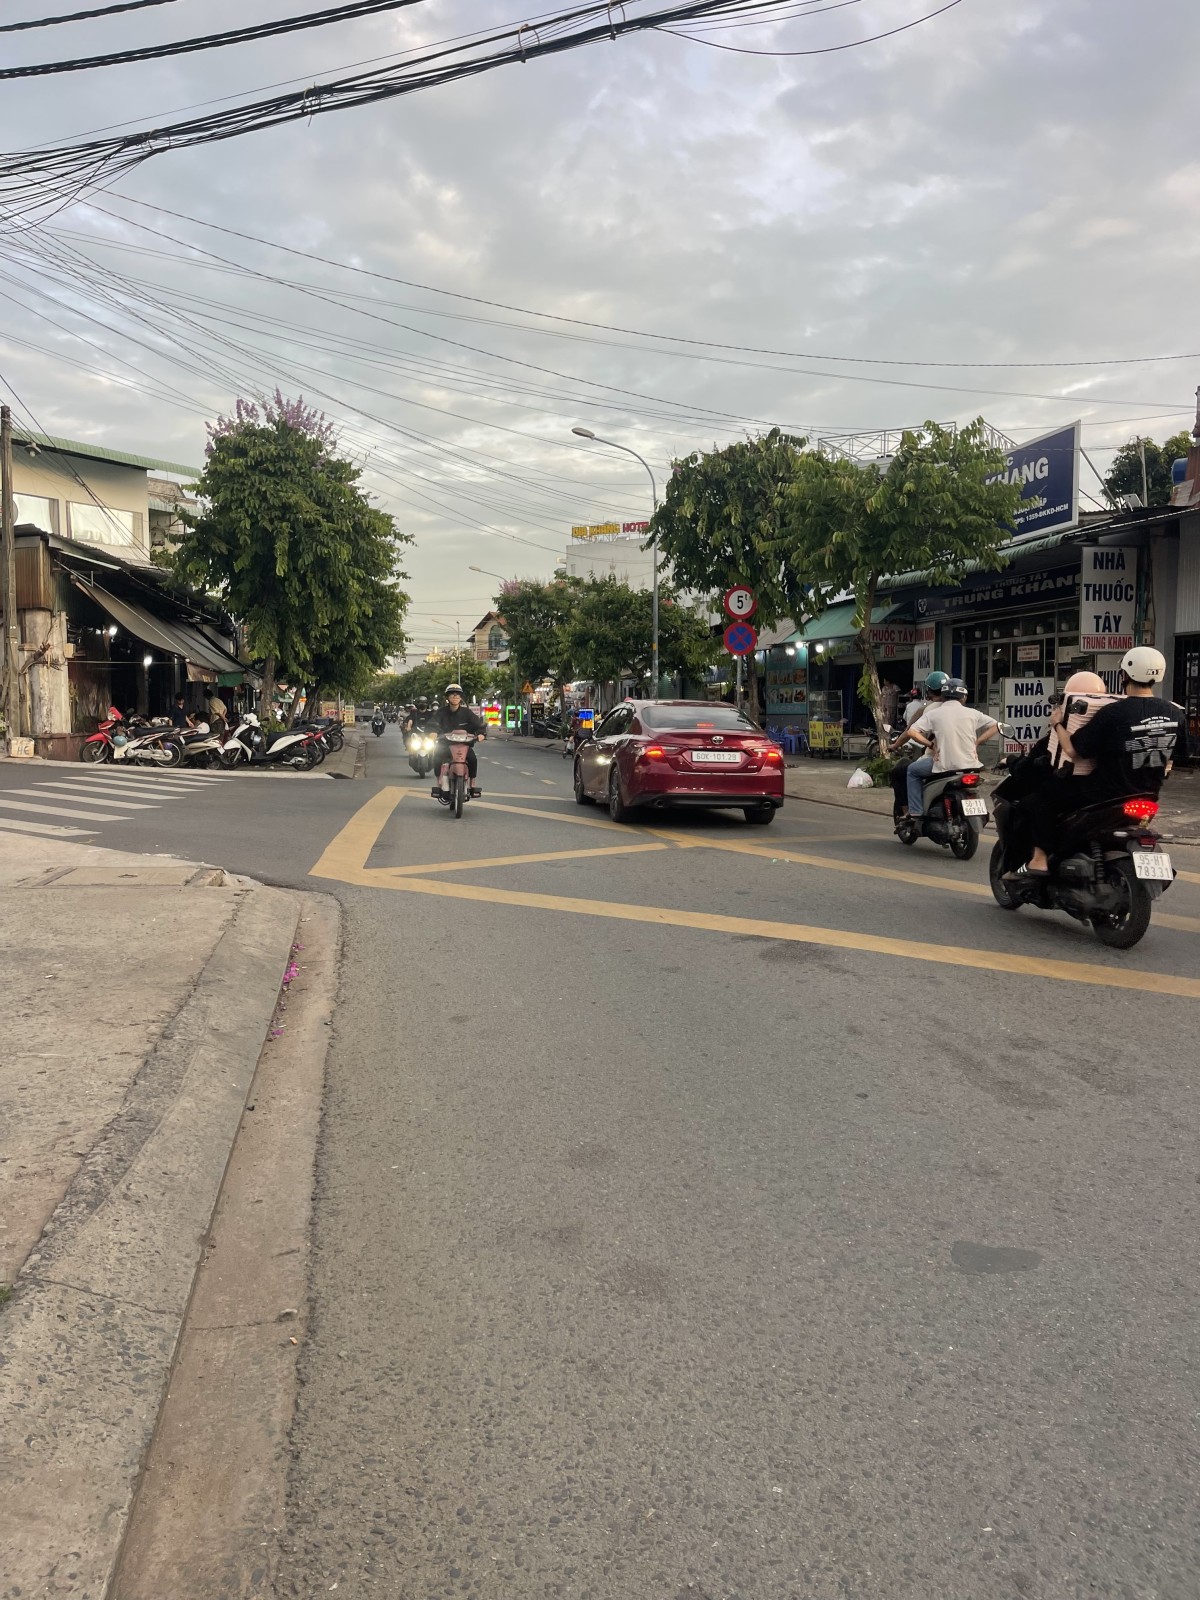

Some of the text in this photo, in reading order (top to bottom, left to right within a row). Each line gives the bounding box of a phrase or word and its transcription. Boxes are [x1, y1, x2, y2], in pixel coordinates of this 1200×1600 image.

[1093, 549, 1126, 570] NHÀ
[943, 588, 1004, 607] TRUNG
[1083, 578, 1134, 602] THUỐC
[1093, 611, 1122, 633] TÂY
[870, 625, 896, 641] HUỐC
[1082, 636, 1133, 650] TRUNG KHANG
[1014, 680, 1044, 696] NHÀ
[1006, 700, 1052, 718] THUỐC
[1016, 723, 1042, 739] TÂY
